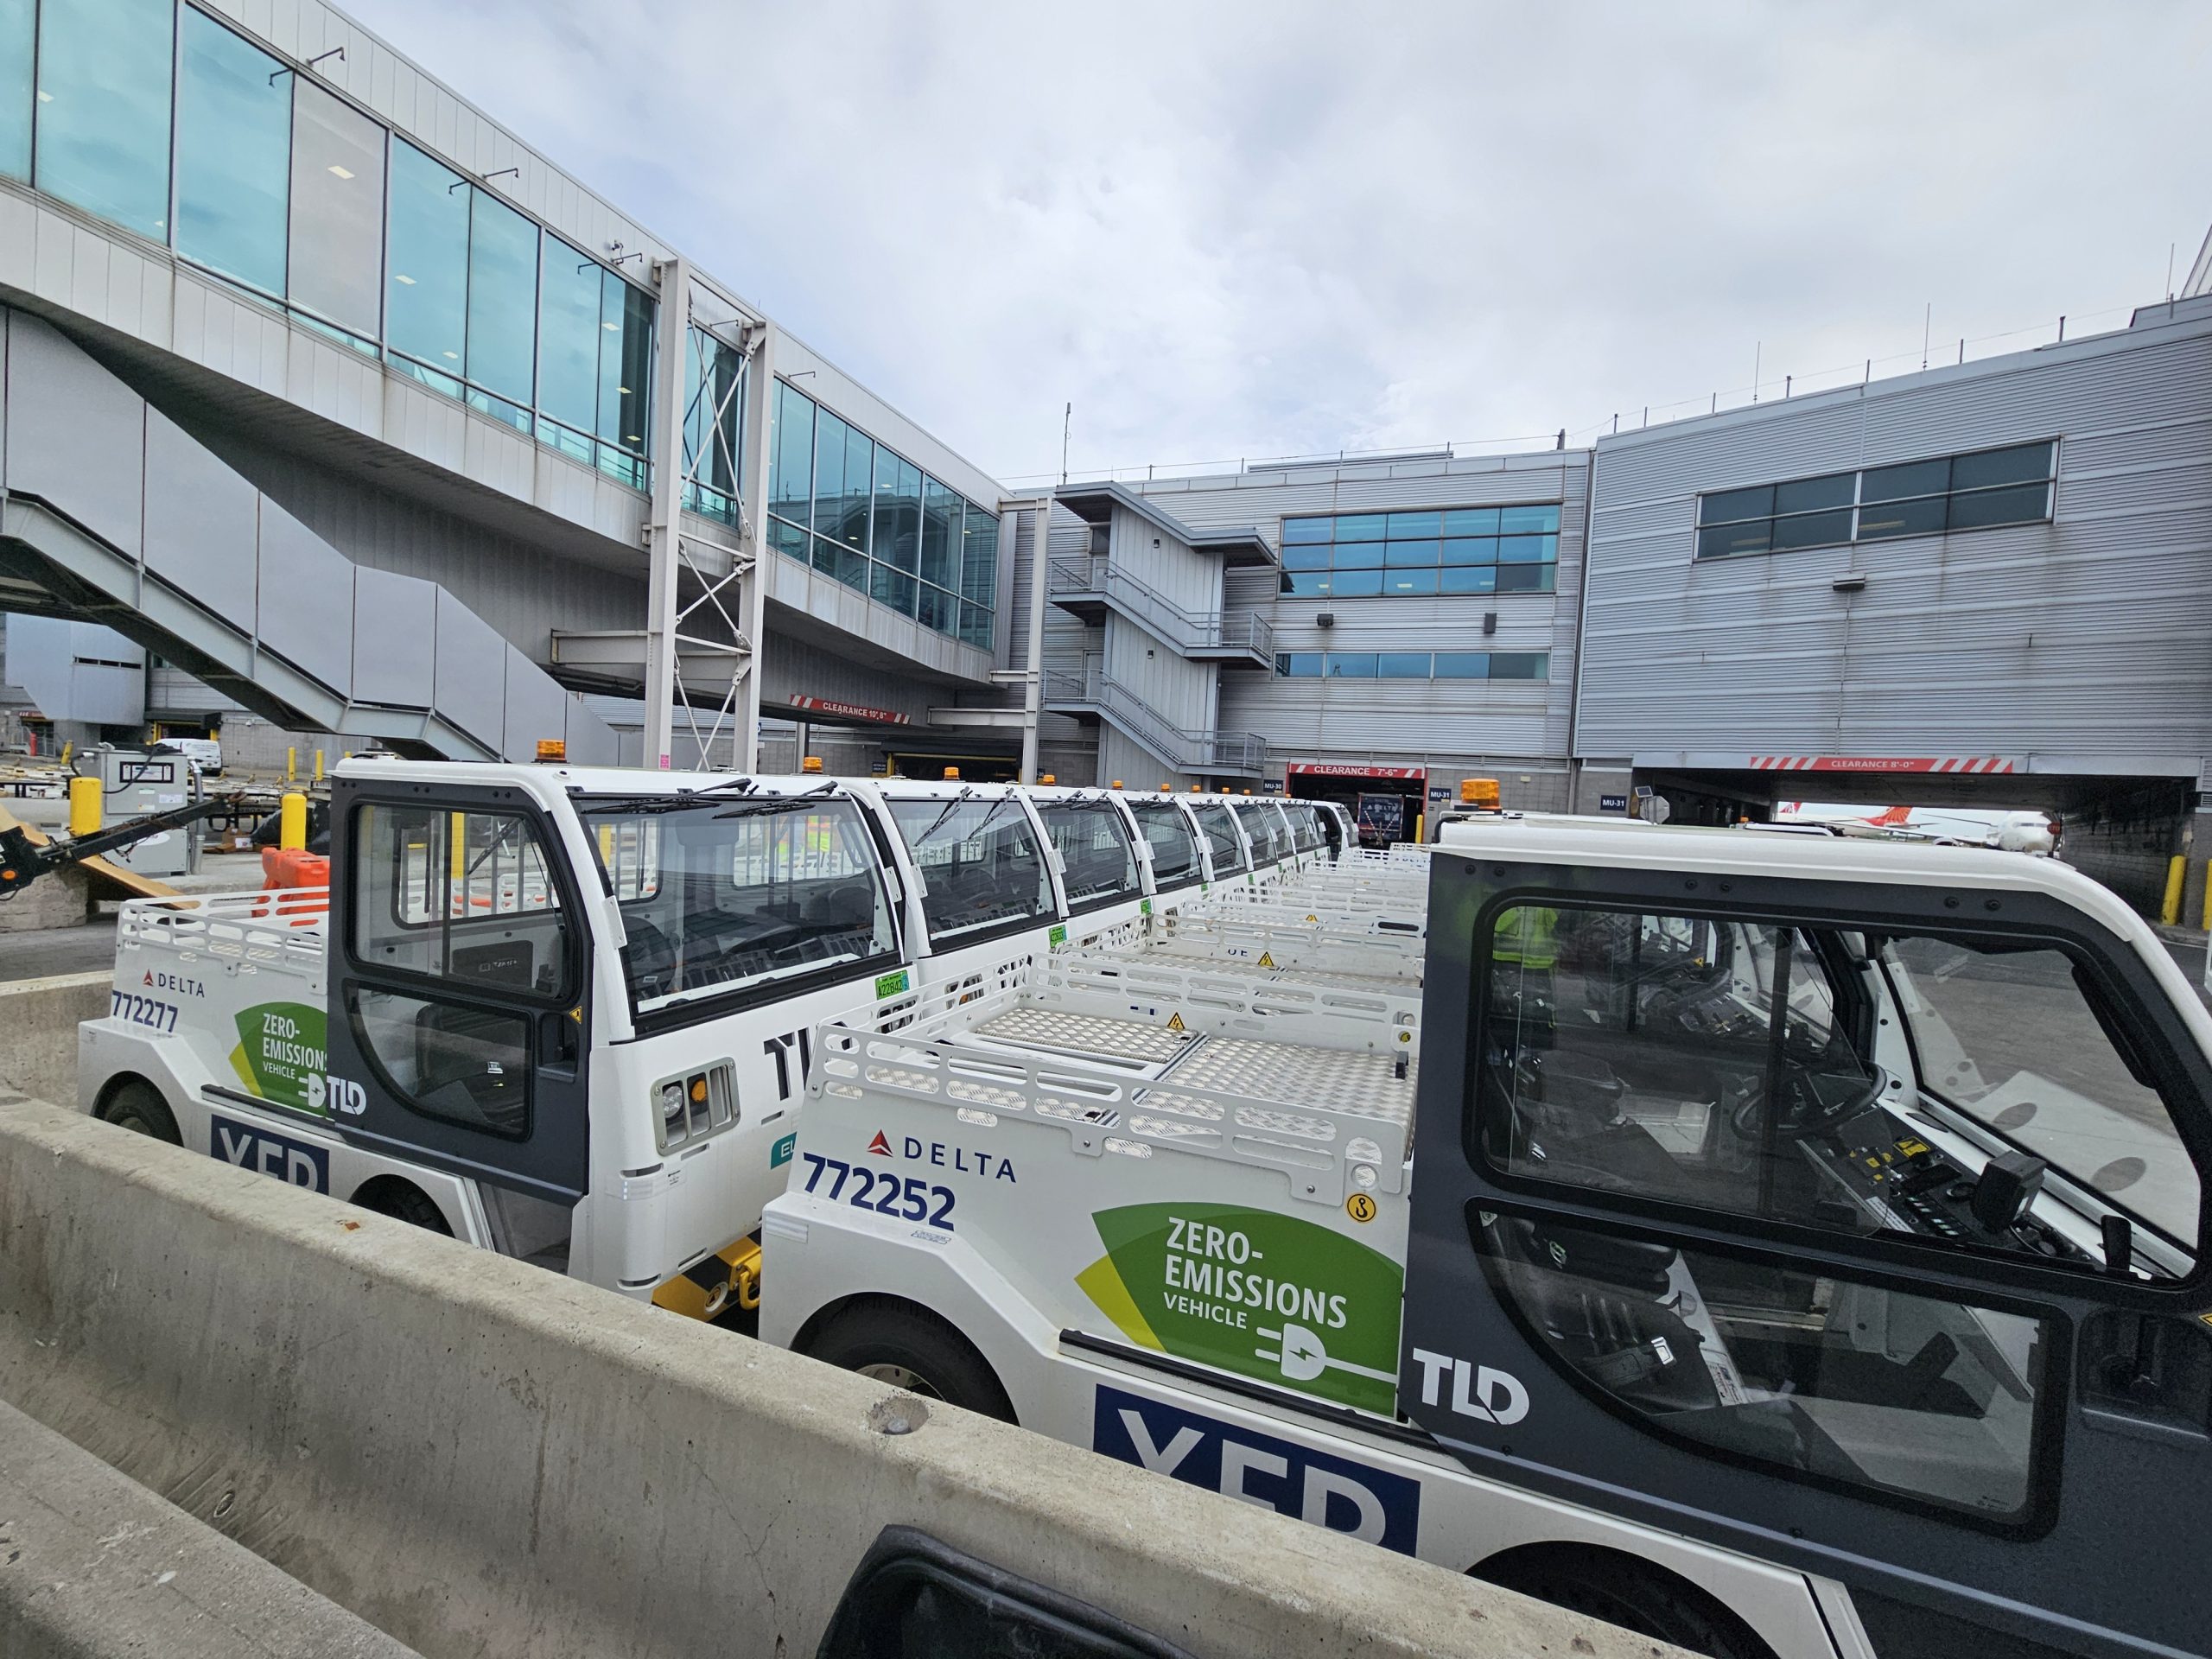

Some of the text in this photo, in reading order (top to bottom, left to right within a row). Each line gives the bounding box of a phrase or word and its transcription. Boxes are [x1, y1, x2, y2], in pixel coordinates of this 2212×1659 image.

[823, 702, 868, 716] CLEARANCE
[1314, 766, 1370, 775] CLEARANCE
[158, 973, 205, 998] DELTA
[112, 989, 178, 1033] 772277
[263, 1013, 301, 1039] ZERO-
[263, 1037, 327, 1071] EMISSION
[263, 1061, 296, 1079] VEHICLE
[327, 1075, 366, 1116] TLD
[905, 1136, 1016, 1184] DELTA
[804, 1152, 956, 1231] 772252
[1166, 1217, 1263, 1264] ZERO-
[1163, 1292, 1248, 1329] VEHICLE
[1166, 1254, 1347, 1329] EMISSIONS
[1413, 1347, 1529, 1425] TLD
